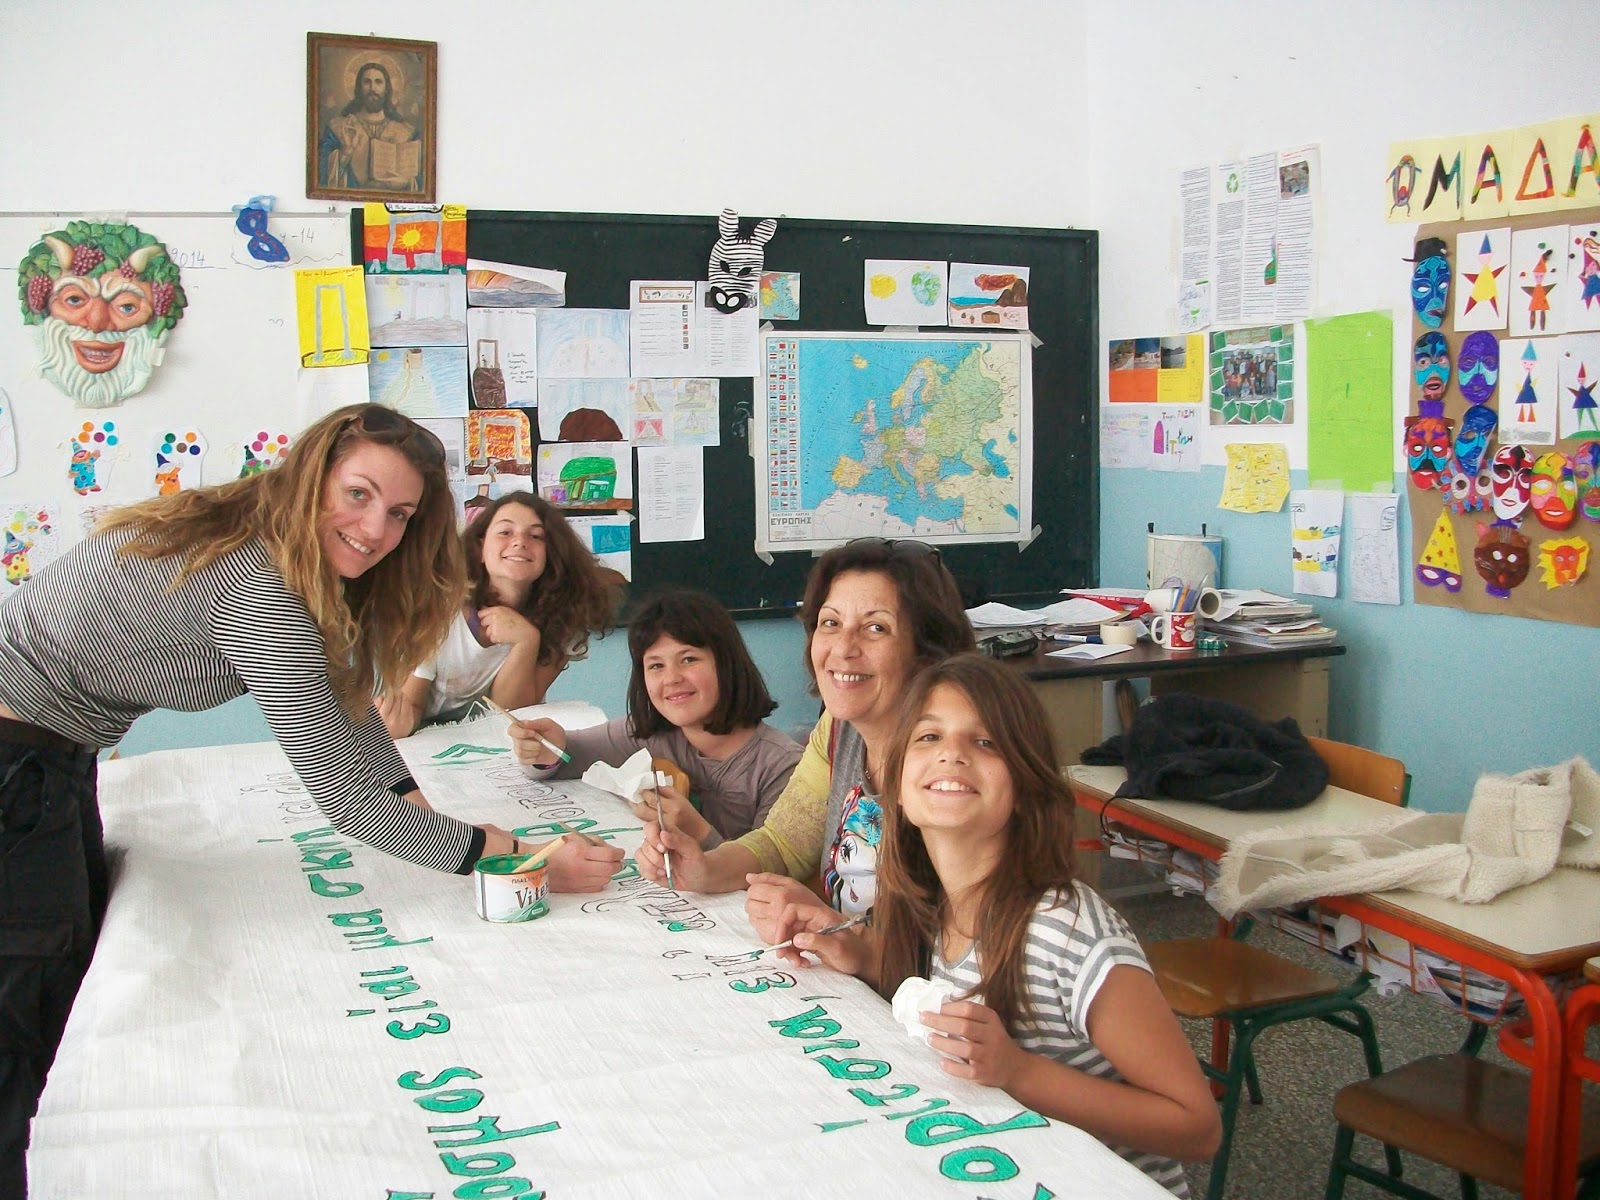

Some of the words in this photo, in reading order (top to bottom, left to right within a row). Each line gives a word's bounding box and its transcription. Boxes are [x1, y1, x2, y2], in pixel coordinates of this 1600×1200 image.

[1386, 123, 1600, 218] ΟΜΑΔΑ
[327, 907, 435, 952] μια
[768, 995, 1054, 1200] ορίτσια,
